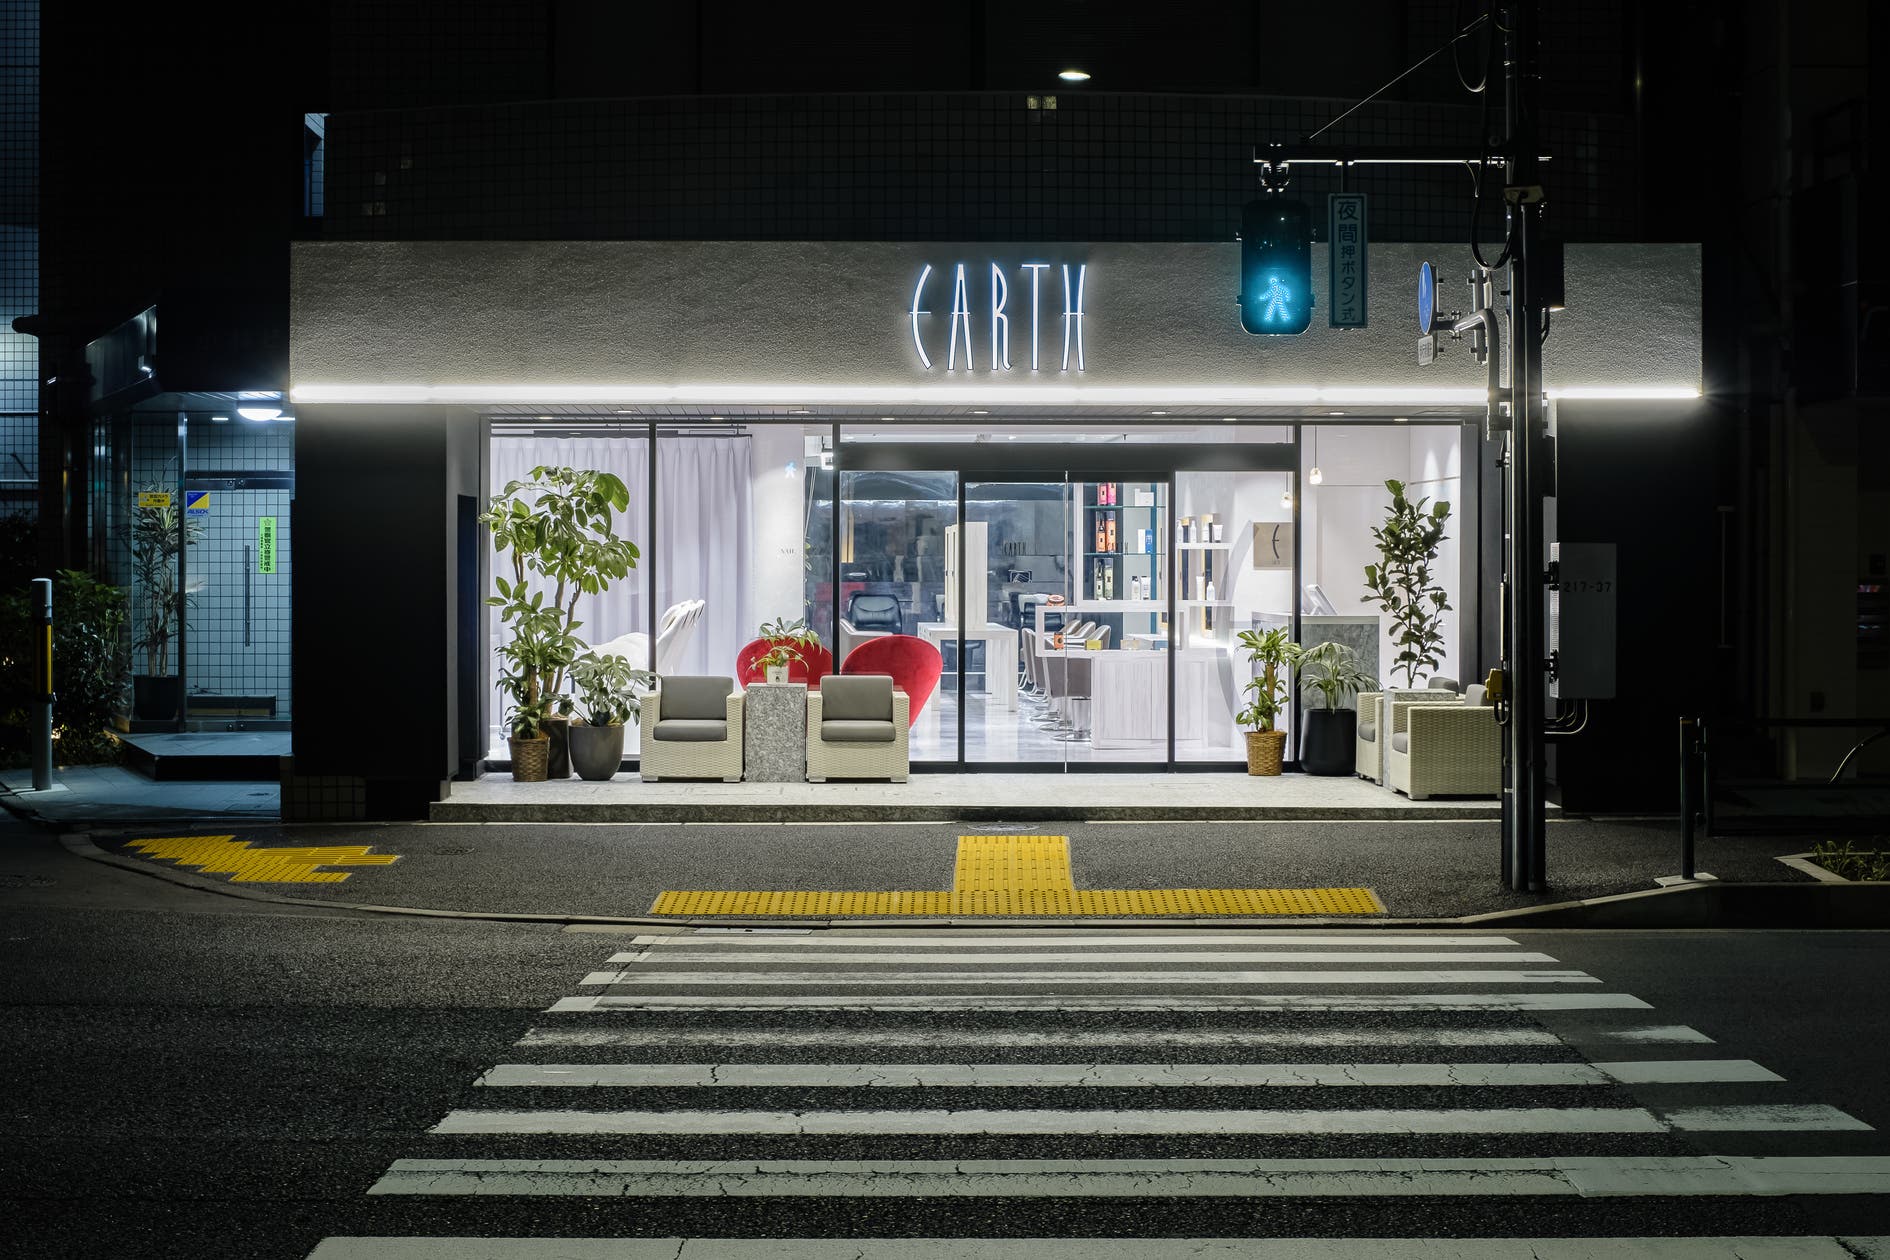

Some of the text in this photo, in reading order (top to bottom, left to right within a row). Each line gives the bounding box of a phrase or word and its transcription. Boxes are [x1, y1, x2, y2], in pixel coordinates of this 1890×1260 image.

[909, 263, 1087, 371] EARTH
[1338, 200, 1360, 322] 夜間押ボタン式
